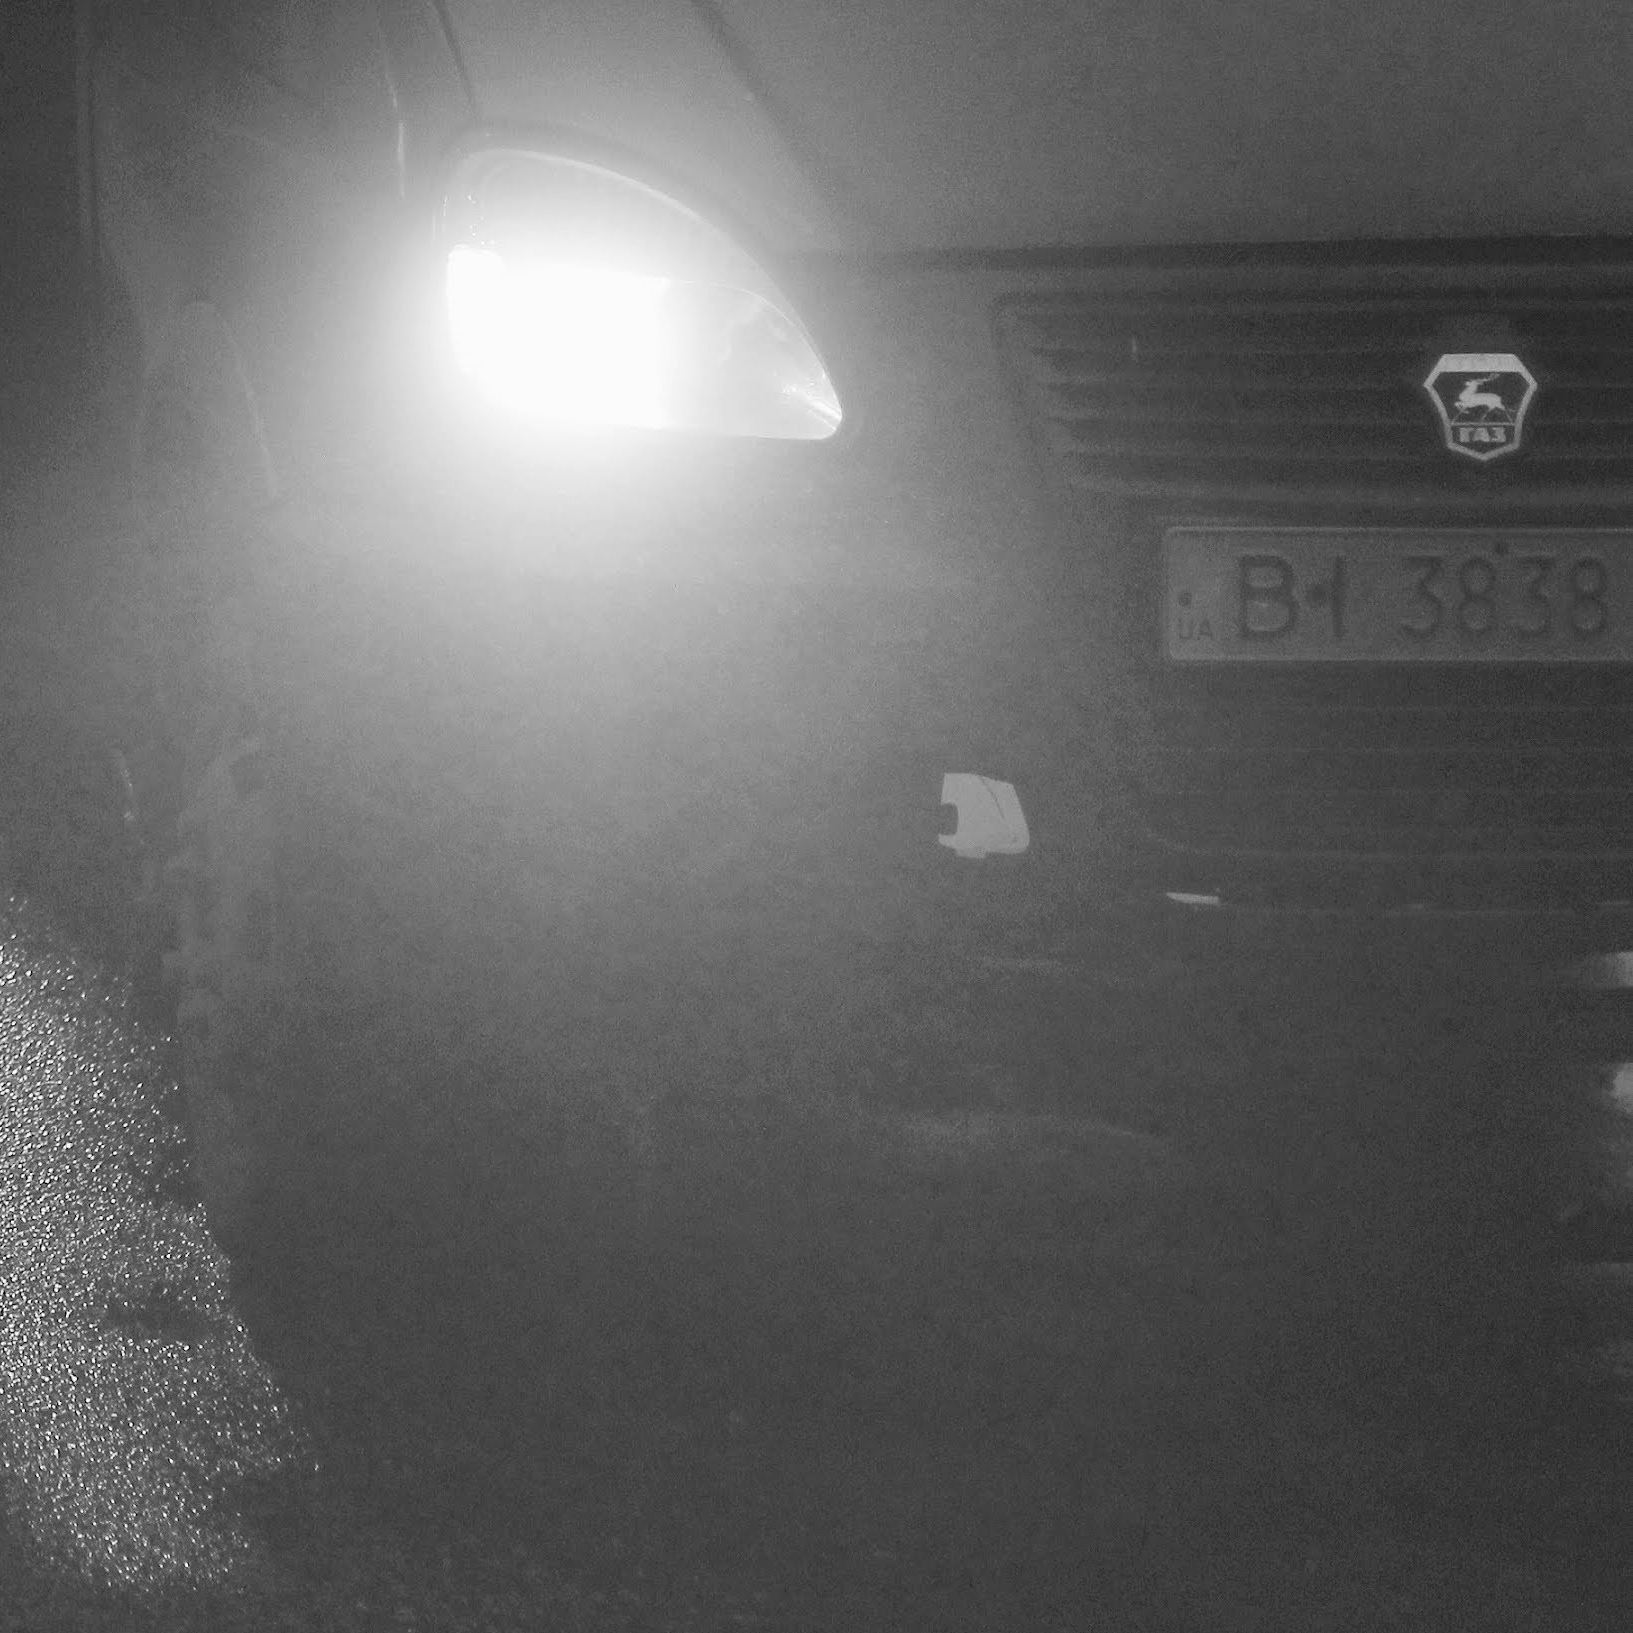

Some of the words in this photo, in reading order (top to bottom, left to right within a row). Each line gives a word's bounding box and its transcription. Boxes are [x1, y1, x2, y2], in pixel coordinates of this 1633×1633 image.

[1459, 425, 1507, 444] ГАЗ
[1399, 554, 1612, 640] 3838
[1176, 616, 1215, 642] UA
